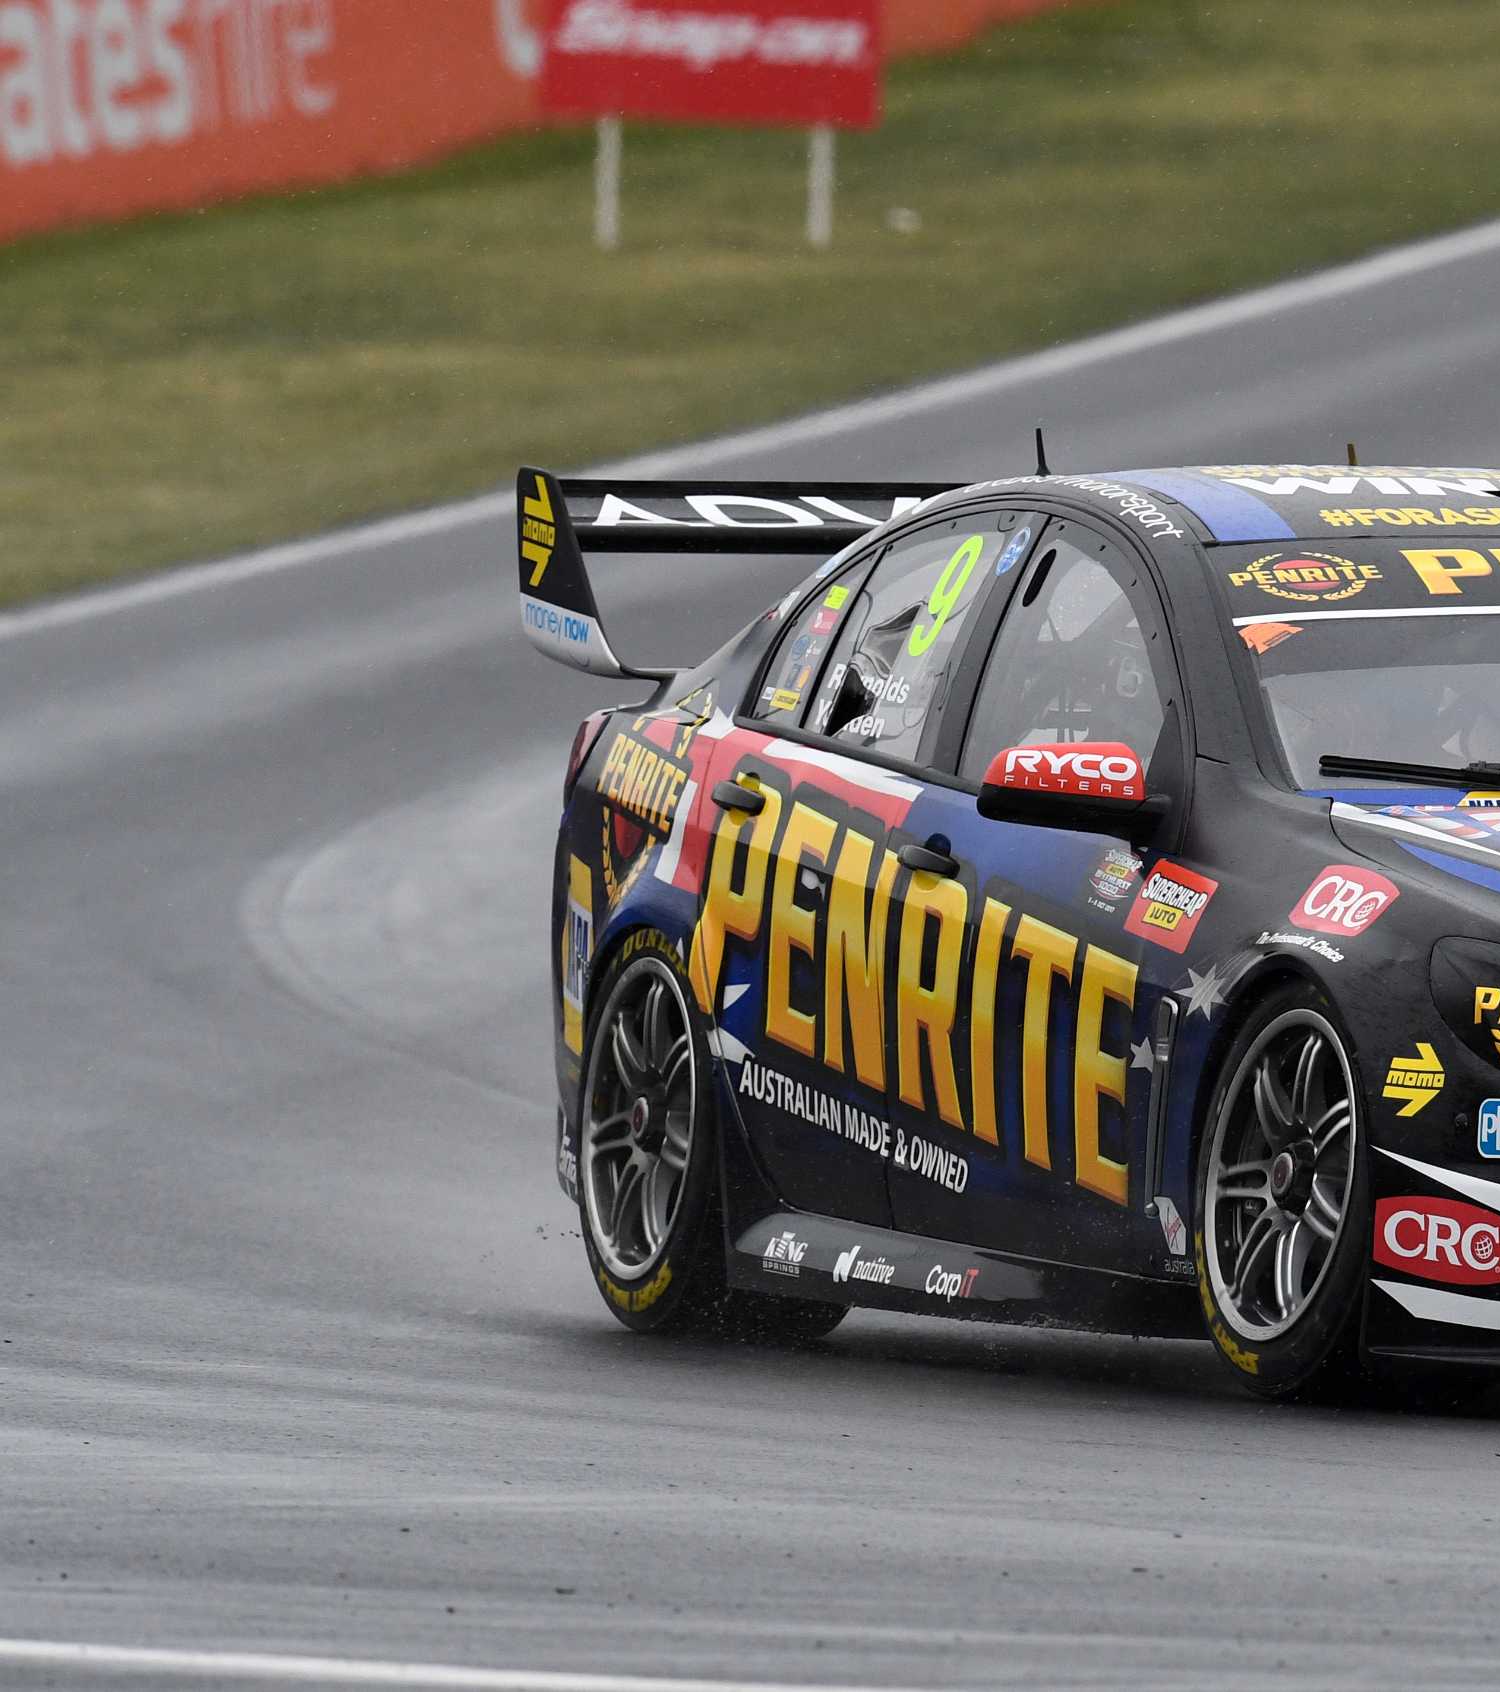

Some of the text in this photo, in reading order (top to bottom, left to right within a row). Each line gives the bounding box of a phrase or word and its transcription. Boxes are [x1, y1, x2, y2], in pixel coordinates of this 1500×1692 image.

[909, 534, 983, 656] 9
[1228, 565, 1383, 587] PENRITE
[828, 663, 910, 704] Rnolds
[815, 699, 885, 738] Yden
[597, 732, 688, 833] PENRITE
[1003, 774, 1135, 796] FILTERS
[1005, 749, 1138, 782] RYCO
[1142, 873, 1208, 918] SUPERCHEAP
[1304, 875, 1389, 928] CRC
[1309, 940, 1346, 963] Choice
[688, 772, 1139, 1206] PENRITE
[739, 1059, 969, 1195] AUSTRALIAN MADE & OWNED
[1383, 1210, 1500, 1272] CRC
